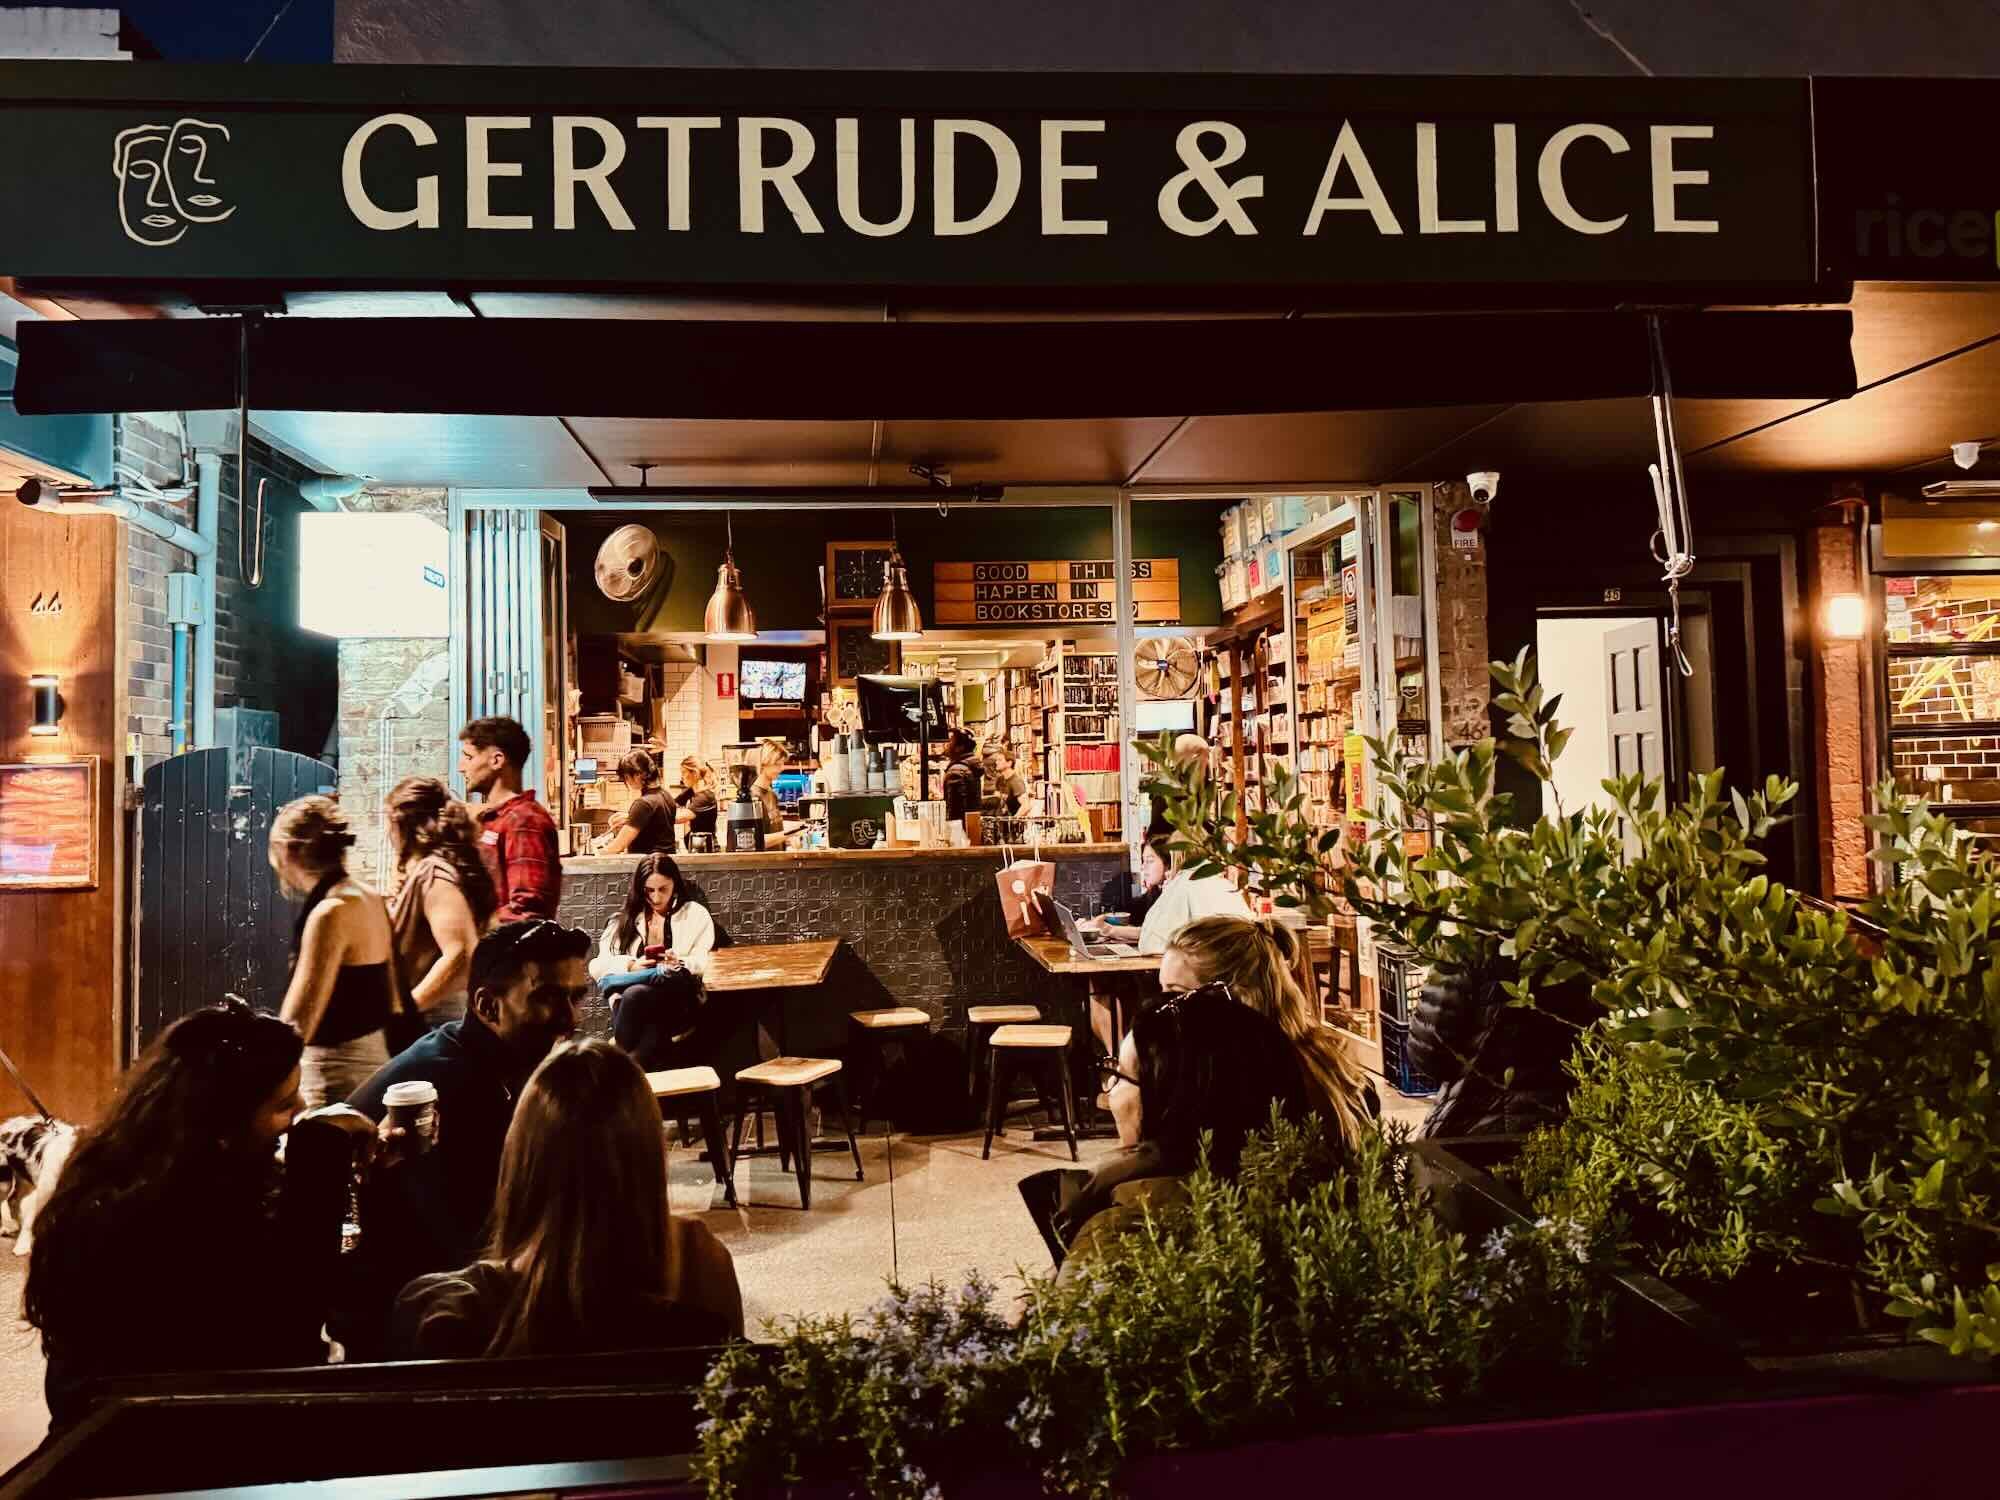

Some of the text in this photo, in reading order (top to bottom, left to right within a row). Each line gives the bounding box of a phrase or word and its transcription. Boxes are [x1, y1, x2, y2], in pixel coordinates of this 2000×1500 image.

[341, 113, 1719, 237] GERTRUDE & ALICE
[1855, 191, 2000, 272] rice
[1454, 539, 1477, 550] FIRE
[975, 562, 1150, 580] GOOD THIGS
[976, 583, 1097, 600] HAPPEN IN
[31, 591, 63, 617] 44
[976, 603, 1111, 619] BOOKSTORES
